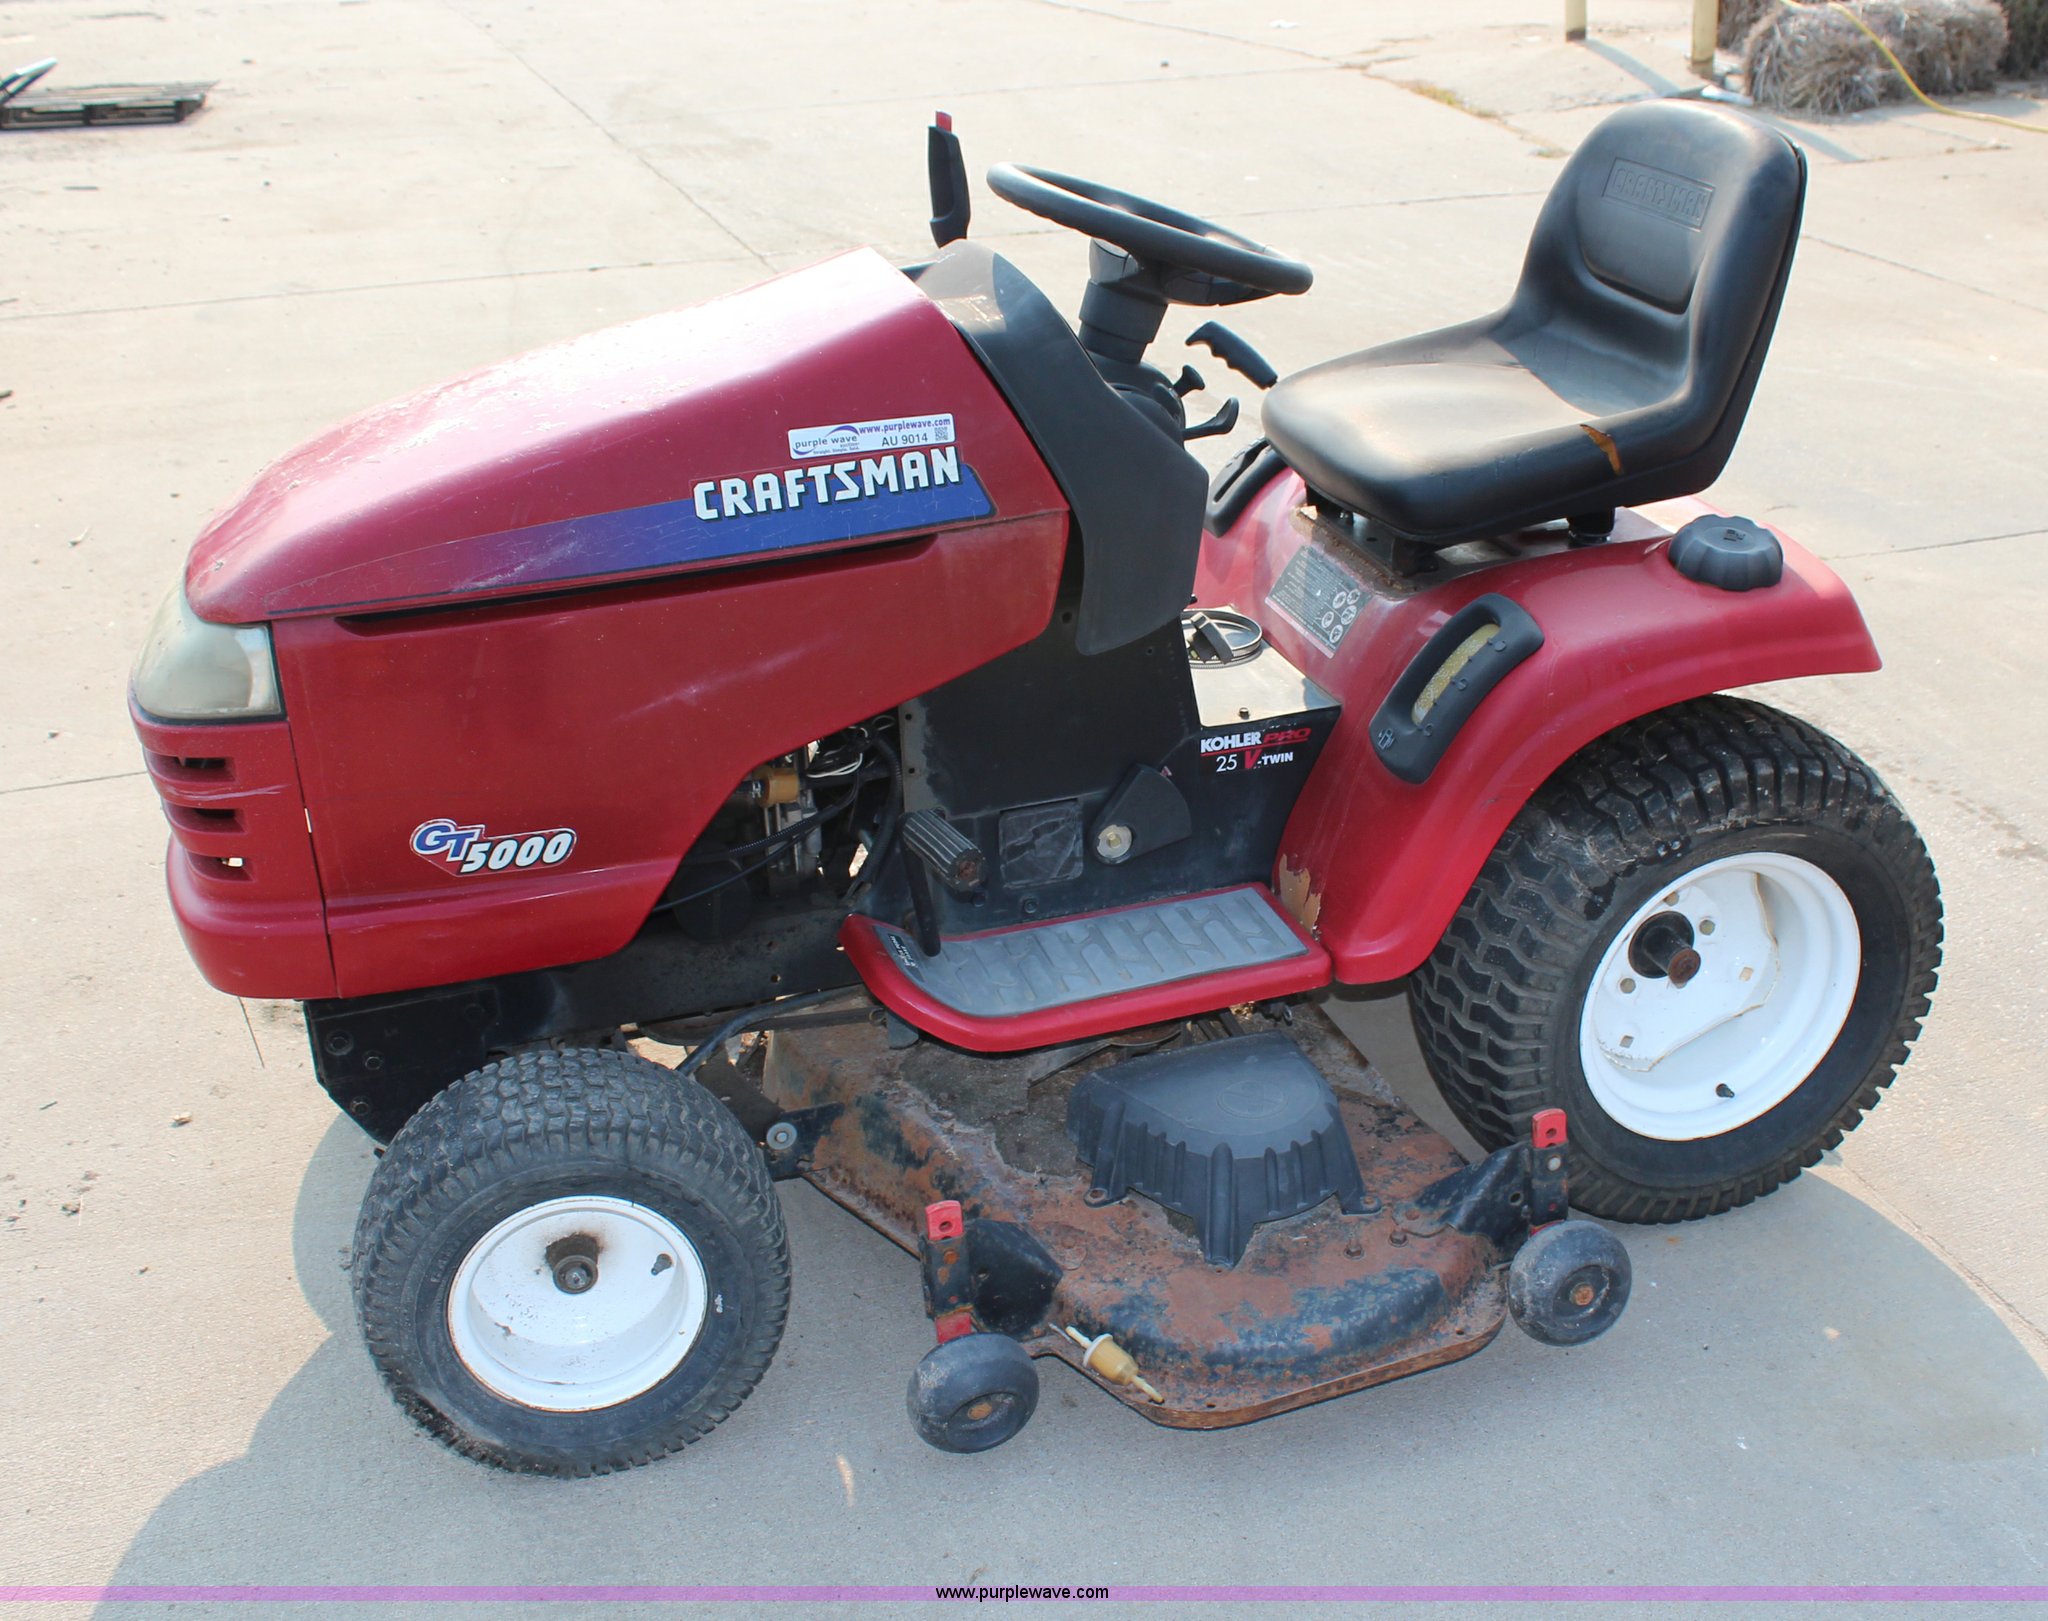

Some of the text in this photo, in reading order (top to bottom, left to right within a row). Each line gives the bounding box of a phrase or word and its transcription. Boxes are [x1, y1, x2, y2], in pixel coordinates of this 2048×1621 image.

[859, 418, 951, 434] www.purplewave.com
[795, 435, 858, 449] purple wave
[881, 433, 928, 447] AU 9014
[693, 446, 961, 522] CRAFTSMAN
[1200, 727, 1312, 753] KOHLER PRO
[1216, 754, 1237, 772] 25
